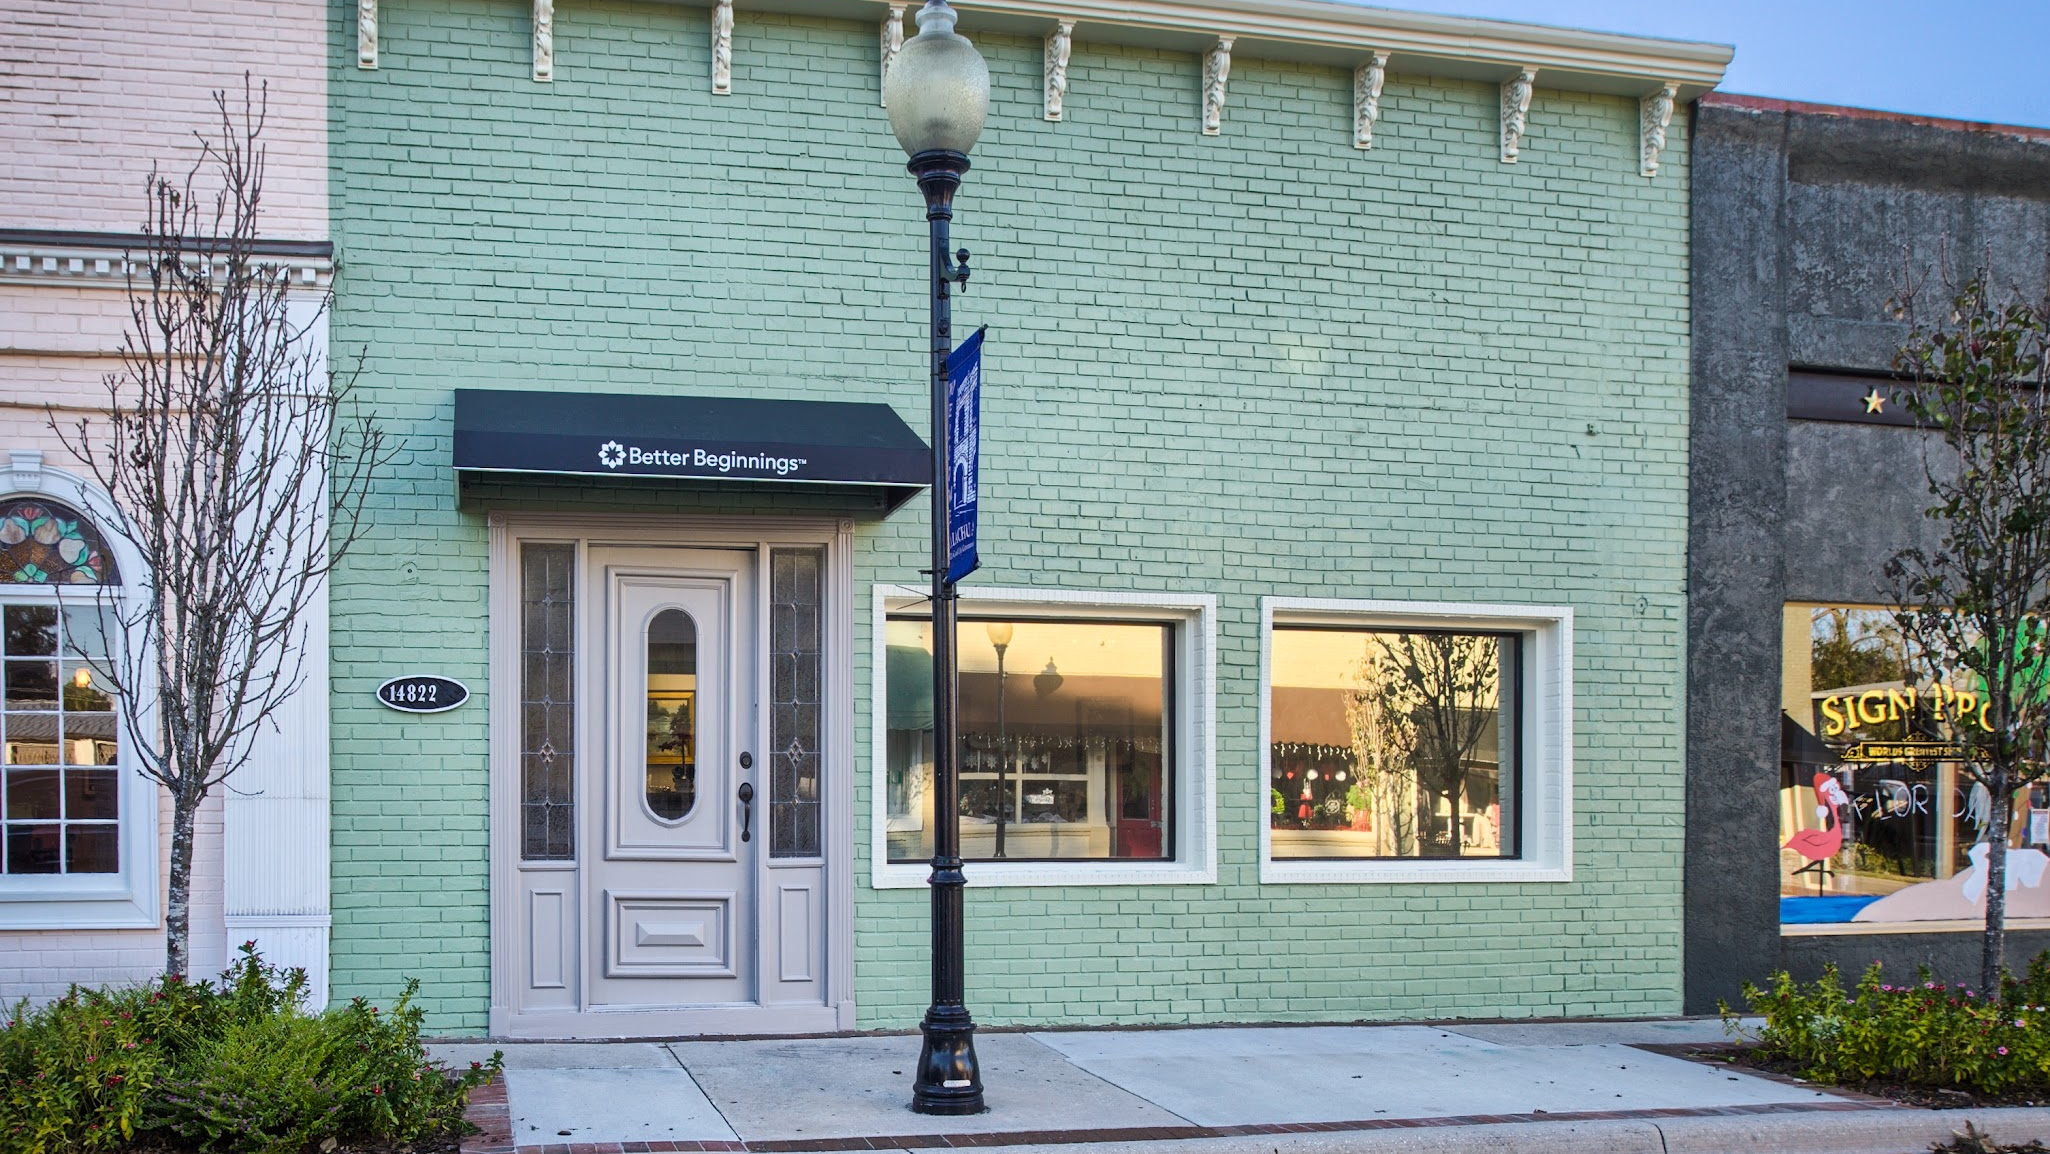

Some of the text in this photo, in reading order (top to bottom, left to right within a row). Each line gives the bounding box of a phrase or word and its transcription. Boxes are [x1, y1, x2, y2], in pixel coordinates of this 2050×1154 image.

[629, 446, 690, 466] Better
[389, 684, 437, 703] 14822
[1821, 687, 1917, 736] SIGN
